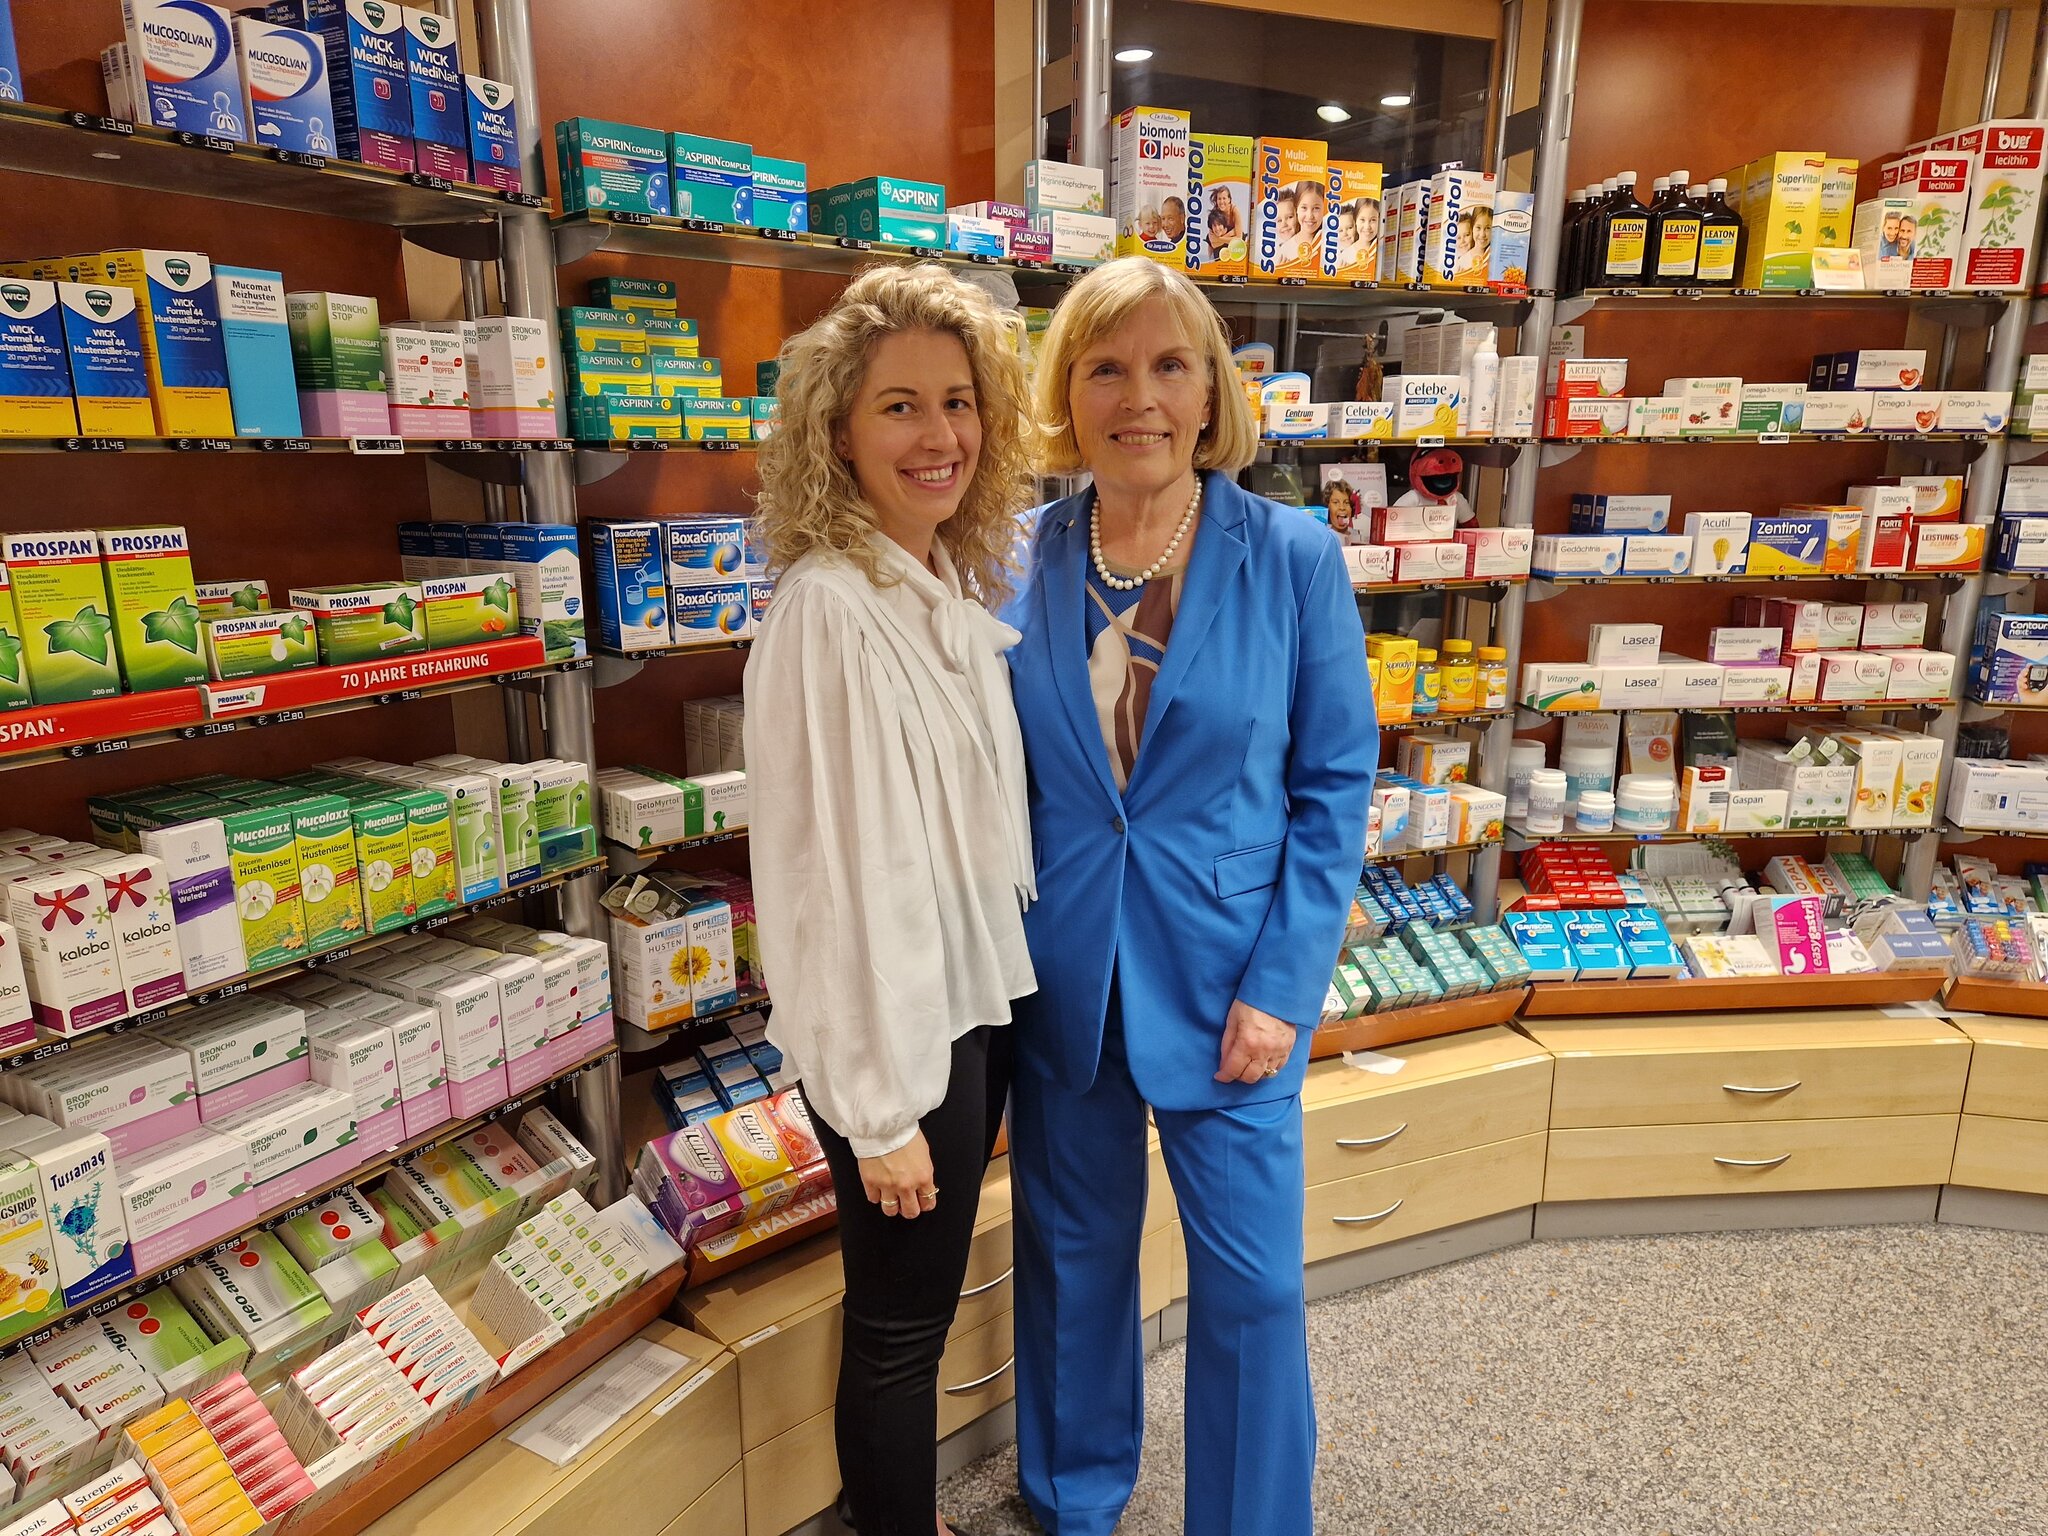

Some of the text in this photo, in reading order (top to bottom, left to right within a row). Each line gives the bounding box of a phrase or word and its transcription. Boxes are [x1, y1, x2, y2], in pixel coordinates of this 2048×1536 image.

[365, 10, 384, 20] WICK
[421, 23, 440, 34] WICK
[143, 22, 213, 49] MUCOSOLVAN
[360, 34, 394, 55] WICK
[249, 49, 307, 71] MUCOSOLVAN
[353, 47, 405, 72] MediNait
[417, 48, 449, 68] WICK
[410, 60, 459, 85] MediNait
[73, 113, 87, 126] €
[482, 111, 506, 126] WICK
[477, 121, 514, 139] MediNait
[1139, 122, 1187, 141] biomont
[182, 132, 234, 152] € 15.90
[591, 137, 664, 157] ASPIRIN COMPLEX
[1999, 131, 2033, 150] buer
[1162, 142, 1186, 159] plus
[1207, 142, 1249, 156] plus Eisen
[1285, 149, 1309, 160] Multi-
[685, 152, 750, 171] ASPIRIN COMPLEX
[1995, 154, 2029, 167] lecithin
[1288, 162, 1324, 174] Vitamine
[1930, 162, 1958, 177] buer
[777, 178, 805, 188] COMPLEX
[1776, 173, 1820, 184] SuperVital
[1347, 180, 1379, 191] Vitamine
[1928, 180, 1956, 191] lecithin
[892, 189, 939, 207] ASPIRIN
[1185, 139, 1204, 271] sanostol
[1260, 145, 1281, 274] sanostol
[991, 205, 1026, 219] AURASIN
[1323, 167, 1344, 278] sanostol
[1613, 223, 1644, 232] LEATON
[1665, 224, 1697, 233] LEATON
[1442, 177, 1463, 282] sanostol
[1704, 230, 1735, 239] LEATON
[1014, 232, 1050, 245] AURASIN
[167, 266, 190, 276] WICK
[232, 280, 272, 292] Mucomat
[619, 280, 650, 291] ASPIRIN
[3, 292, 30, 302] WICK
[87, 297, 111, 307] WICK
[172, 298, 195, 307] WICK
[230, 290, 276, 302] Reizhusten
[165, 306, 204, 316] Formel 44
[331, 302, 368, 315] BRONCHO
[332, 312, 353, 321] STOP
[585, 310, 618, 322] ASPIRIN
[9, 325, 35, 334] WICK
[92, 329, 116, 338] WICK
[511, 325, 541, 336] BRONCHO
[1, 334, 46, 344] Formel 44
[86, 337, 126, 347] Formel 44
[334, 336, 380, 348] ERKÄLTUNGSSAFT
[395, 336, 427, 346] BRONCHO
[512, 334, 529, 342] STOP
[397, 344, 413, 352] STOP
[589, 355, 623, 366] ASPIRIN
[1568, 366, 1606, 374] ARTERIN
[1405, 382, 1447, 396] Cetebe
[618, 398, 653, 408] ASPIRIN
[693, 400, 725, 410] ASPIRIN
[1571, 405, 1608, 413] ARTERIN
[1285, 408, 1314, 418] Centrum
[1345, 405, 1379, 417] Cetebe
[1660, 413, 1679, 421] PLUS
[67, 440, 125, 450] € 11.45
[180, 439, 230, 450] € 14.95
[263, 439, 311, 450] € 15.50
[1702, 517, 1731, 528] Acutil
[1832, 512, 1862, 521] Pharmaton
[1757, 521, 1812, 536] Zentinor
[1880, 519, 1903, 528] FORTE
[538, 531, 576, 544] KLOSTERFRAU
[614, 529, 651, 539] BoxaGrippal
[672, 529, 740, 546] BoxaGrippal
[11, 539, 92, 557] PROSPAN
[112, 534, 183, 552] PROSPAN
[1560, 545, 1601, 554] Gedächtnis
[540, 565, 570, 576] Thymian
[426, 582, 467, 596] PROSPAN
[329, 596, 371, 608] PROSPAN
[677, 589, 745, 607] BoxaGrippal
[216, 620, 277, 633] PROSPAN akut
[1622, 635, 1656, 645] Lasea
[341, 653, 489, 689] 70 JAHRE ERFAHRUNG
[1547, 674, 1579, 684] Vitango
[1624, 677, 1658, 688] Lasea
[217, 694, 244, 704] PROSPAN
[258, 711, 304, 725] € 12.80
[71, 740, 128, 757] € 16.50
[1906, 749, 1939, 761] Caricol
[542, 776, 573, 789] Bionorica
[636, 796, 681, 811] GeloMyrtol
[1732, 794, 1764, 806] Gaspan
[296, 808, 349, 830] Mucolaxx
[233, 821, 290, 845] Mucolaxx
[239, 857, 292, 877] Hustenlöser
[177, 879, 220, 896] Hustensaft
[178, 891, 208, 904] Weleda
[123, 922, 171, 944] kaloba
[1516, 923, 1554, 931] GAVISCON
[1568, 923, 1606, 931] GAVISCON
[645, 925, 683, 943] grintuss
[695, 927, 728, 941] HUSTEN
[1800, 900, 1823, 968] easygastril
[58, 939, 110, 963] kaloba
[648, 939, 682, 954] HUSTEN
[199, 994, 209, 1004] €
[455, 991, 489, 1009] BRONCHO
[457, 1004, 475, 1017] STOP
[398, 1022, 431, 1039] BRONCHO
[11, 1041, 69, 1066] € 22.50
[199, 1040, 236, 1059] BRONCHO
[349, 1041, 384, 1059] BRONCHO
[66, 1085, 109, 1106] BRONCHO
[67, 1100, 90, 1113] STOP
[739, 1108, 778, 1161] Tantills
[683, 1127, 726, 1182] Tantills
[50, 1149, 106, 1192] Tussamag
[378, 1286, 411, 1309] easyangin
[64, 1299, 117, 1328] € 15.00
[46, 1344, 98, 1374] Lemocin
[73, 1362, 125, 1393] Lemocin
[444, 1367, 478, 1392] easyangin
[95, 1382, 147, 1415] Lemocin
[309, 1457, 337, 1479] Bradosol
[75, 1472, 125, 1507] Strepsils
[89, 1501, 139, 1536] Strepsils
